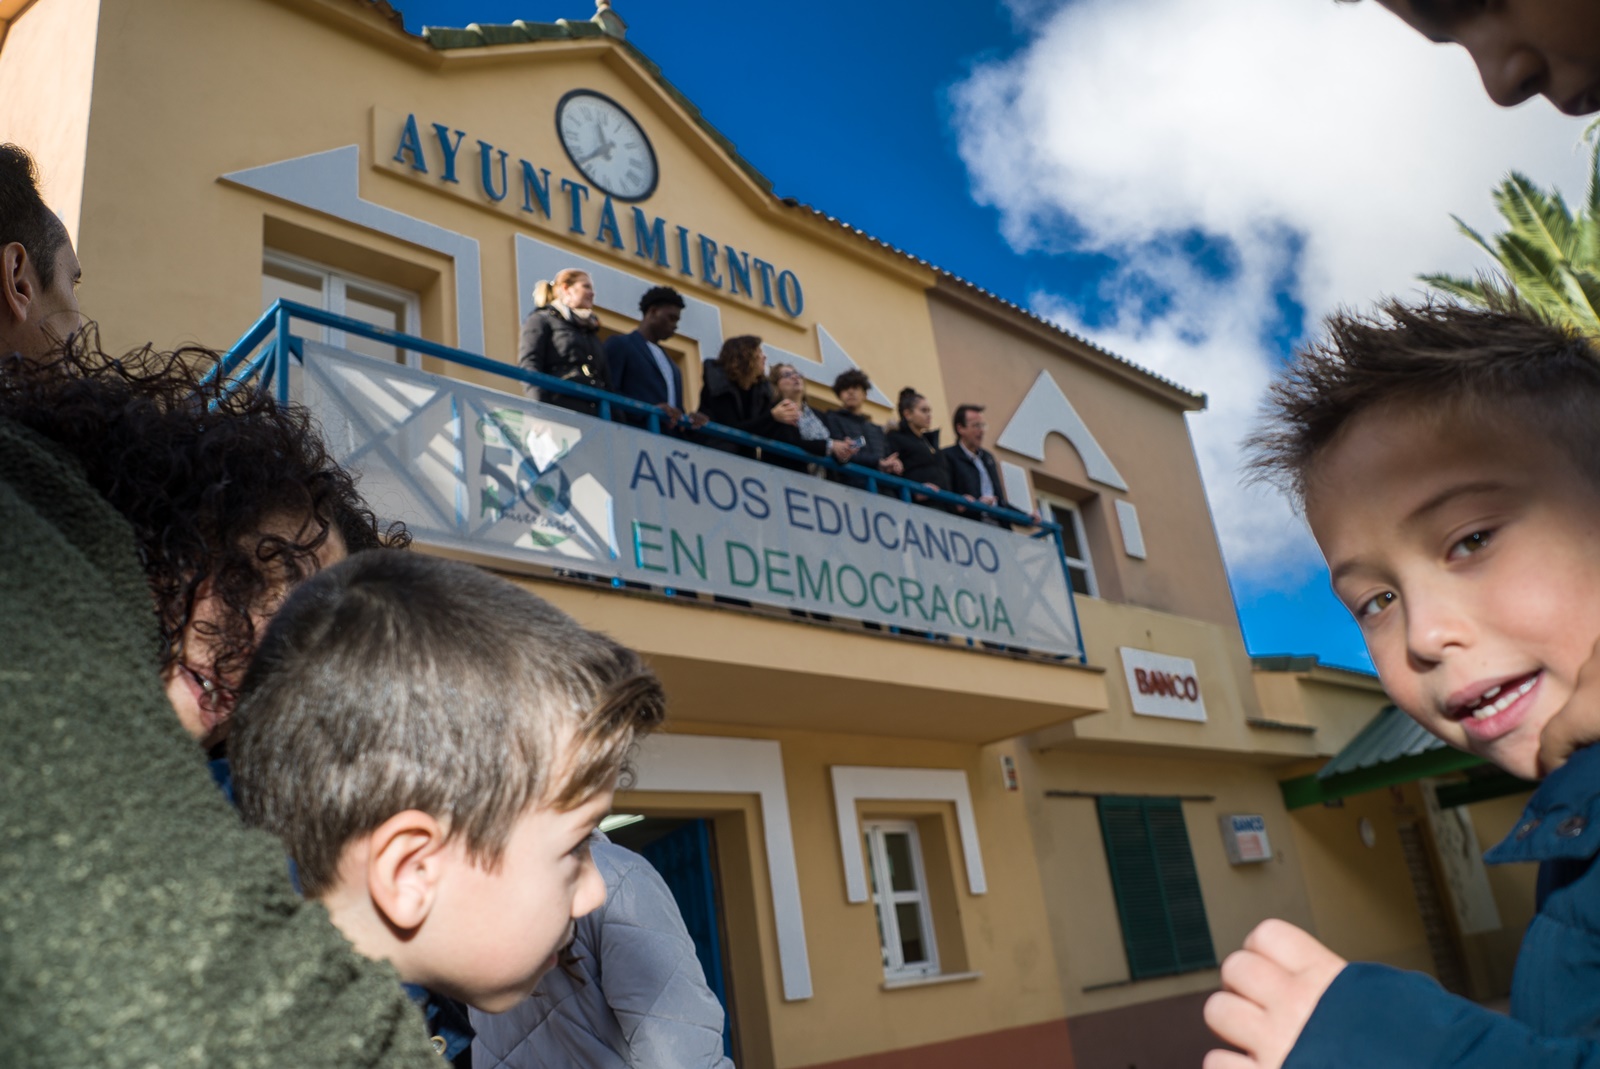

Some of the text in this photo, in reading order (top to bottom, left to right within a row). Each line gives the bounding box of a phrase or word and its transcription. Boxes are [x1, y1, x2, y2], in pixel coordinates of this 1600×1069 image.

[393, 113, 803, 318] AYUNTAMIENTO
[630, 450, 999, 573] AÑOS EDUCANDO
[632, 519, 1015, 635] EN DEMOCRACIA
[1134, 667, 1198, 702] BANCO
